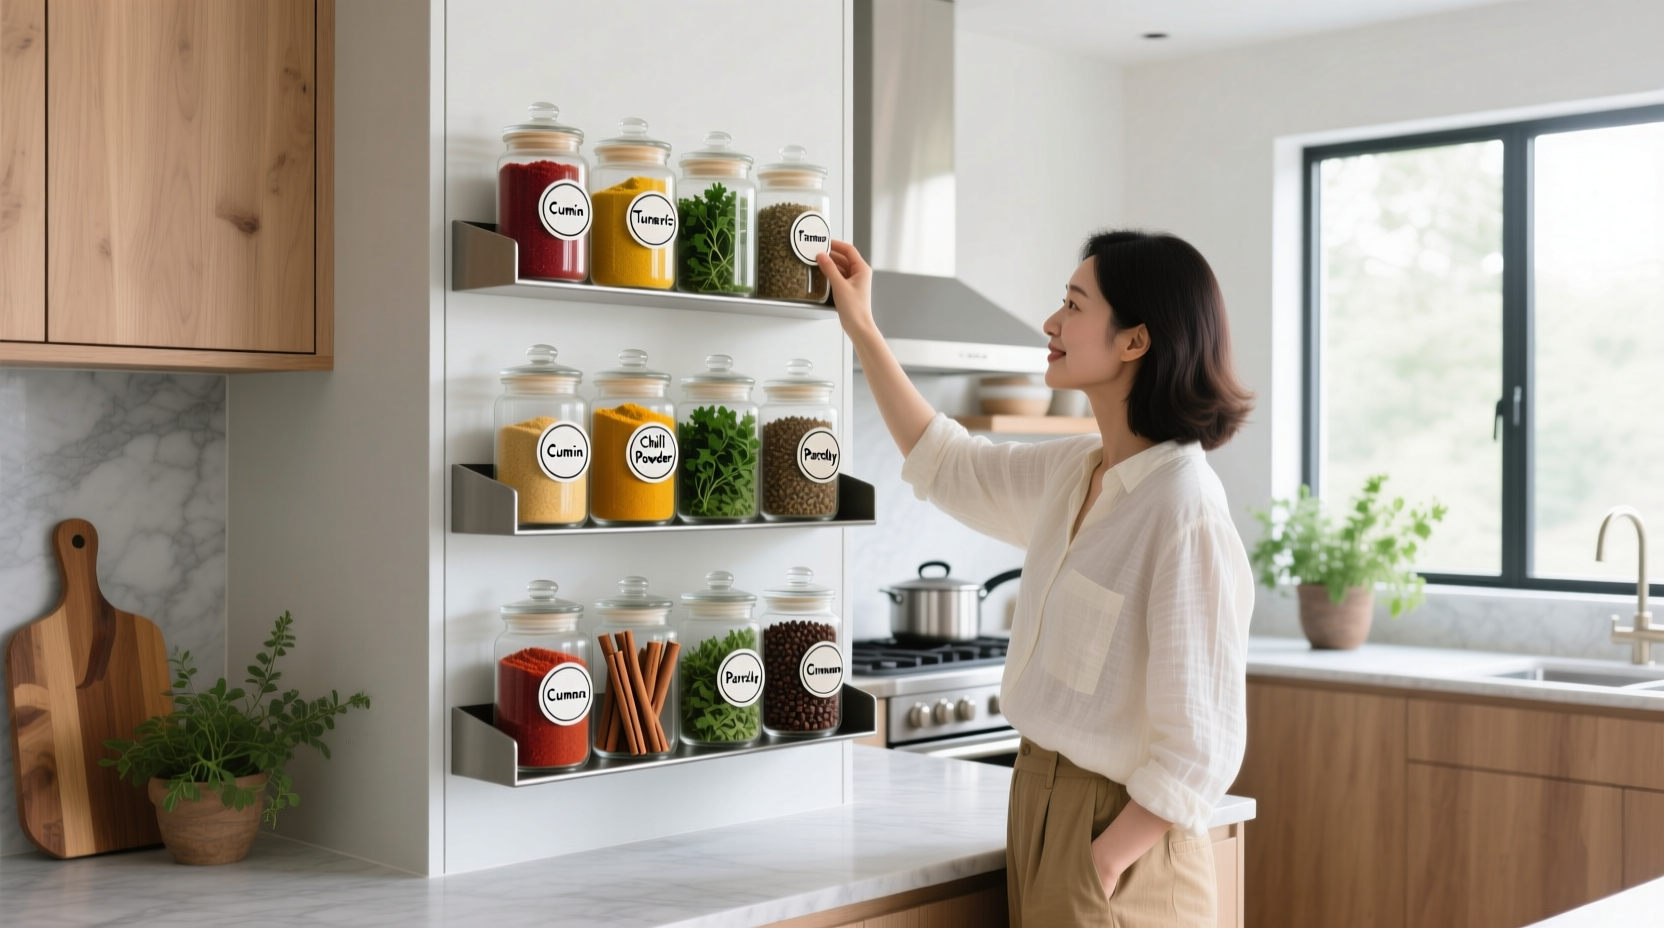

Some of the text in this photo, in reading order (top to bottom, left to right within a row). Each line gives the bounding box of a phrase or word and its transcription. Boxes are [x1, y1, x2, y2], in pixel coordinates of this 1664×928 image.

[549, 201, 584, 216] Cumin
[547, 444, 583, 457] Cumin
[635, 450, 673, 464] Powder
